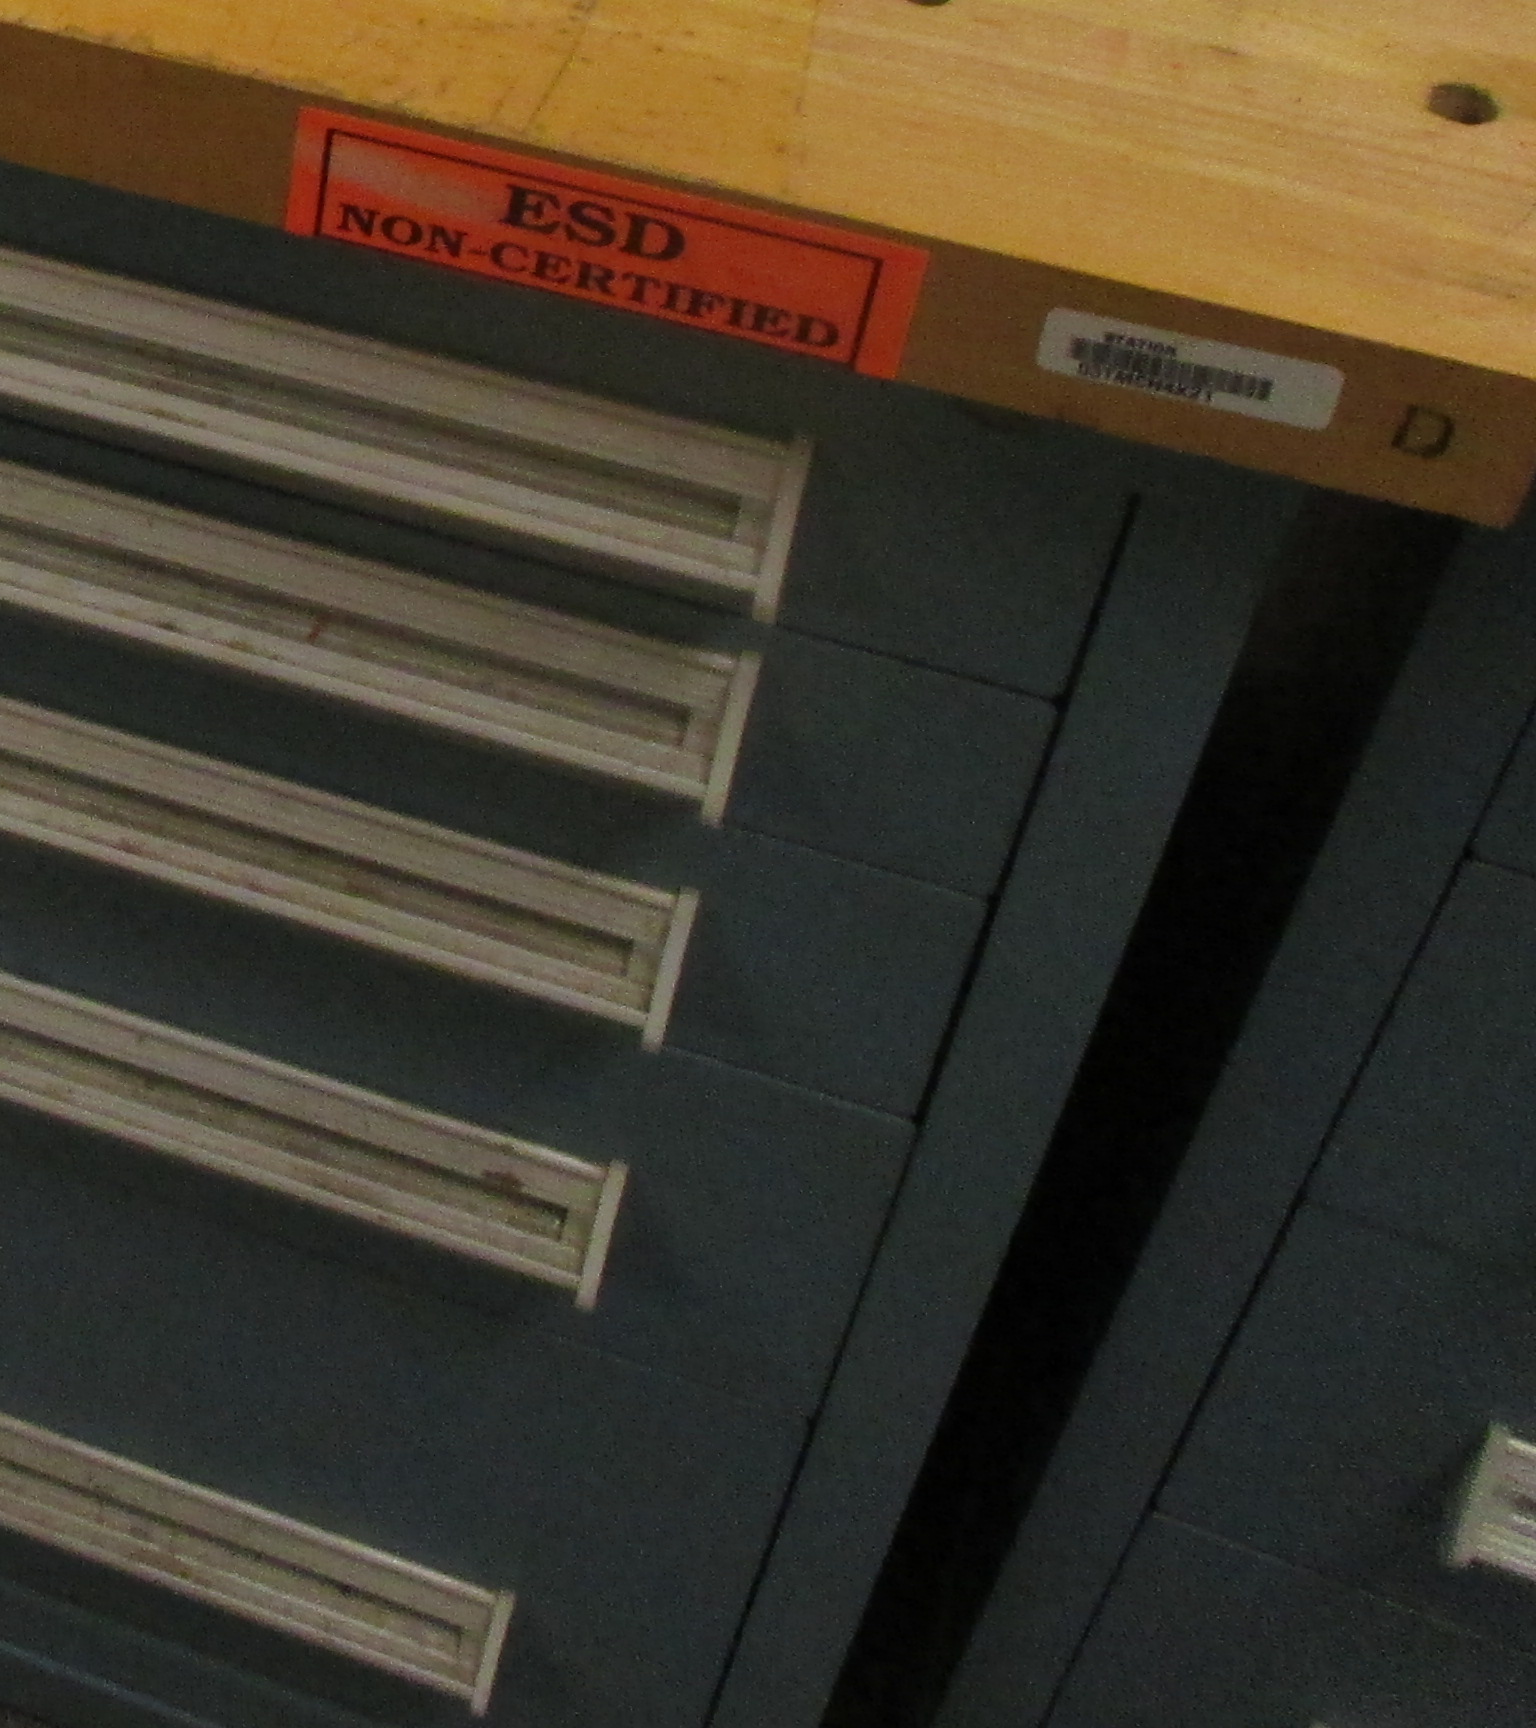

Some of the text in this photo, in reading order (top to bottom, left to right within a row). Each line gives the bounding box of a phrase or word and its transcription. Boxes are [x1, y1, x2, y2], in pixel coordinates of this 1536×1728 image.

[498, 183, 686, 262] ESD
[337, 203, 841, 351] NON-CERTIFIED
[1391, 404, 1455, 459] D
